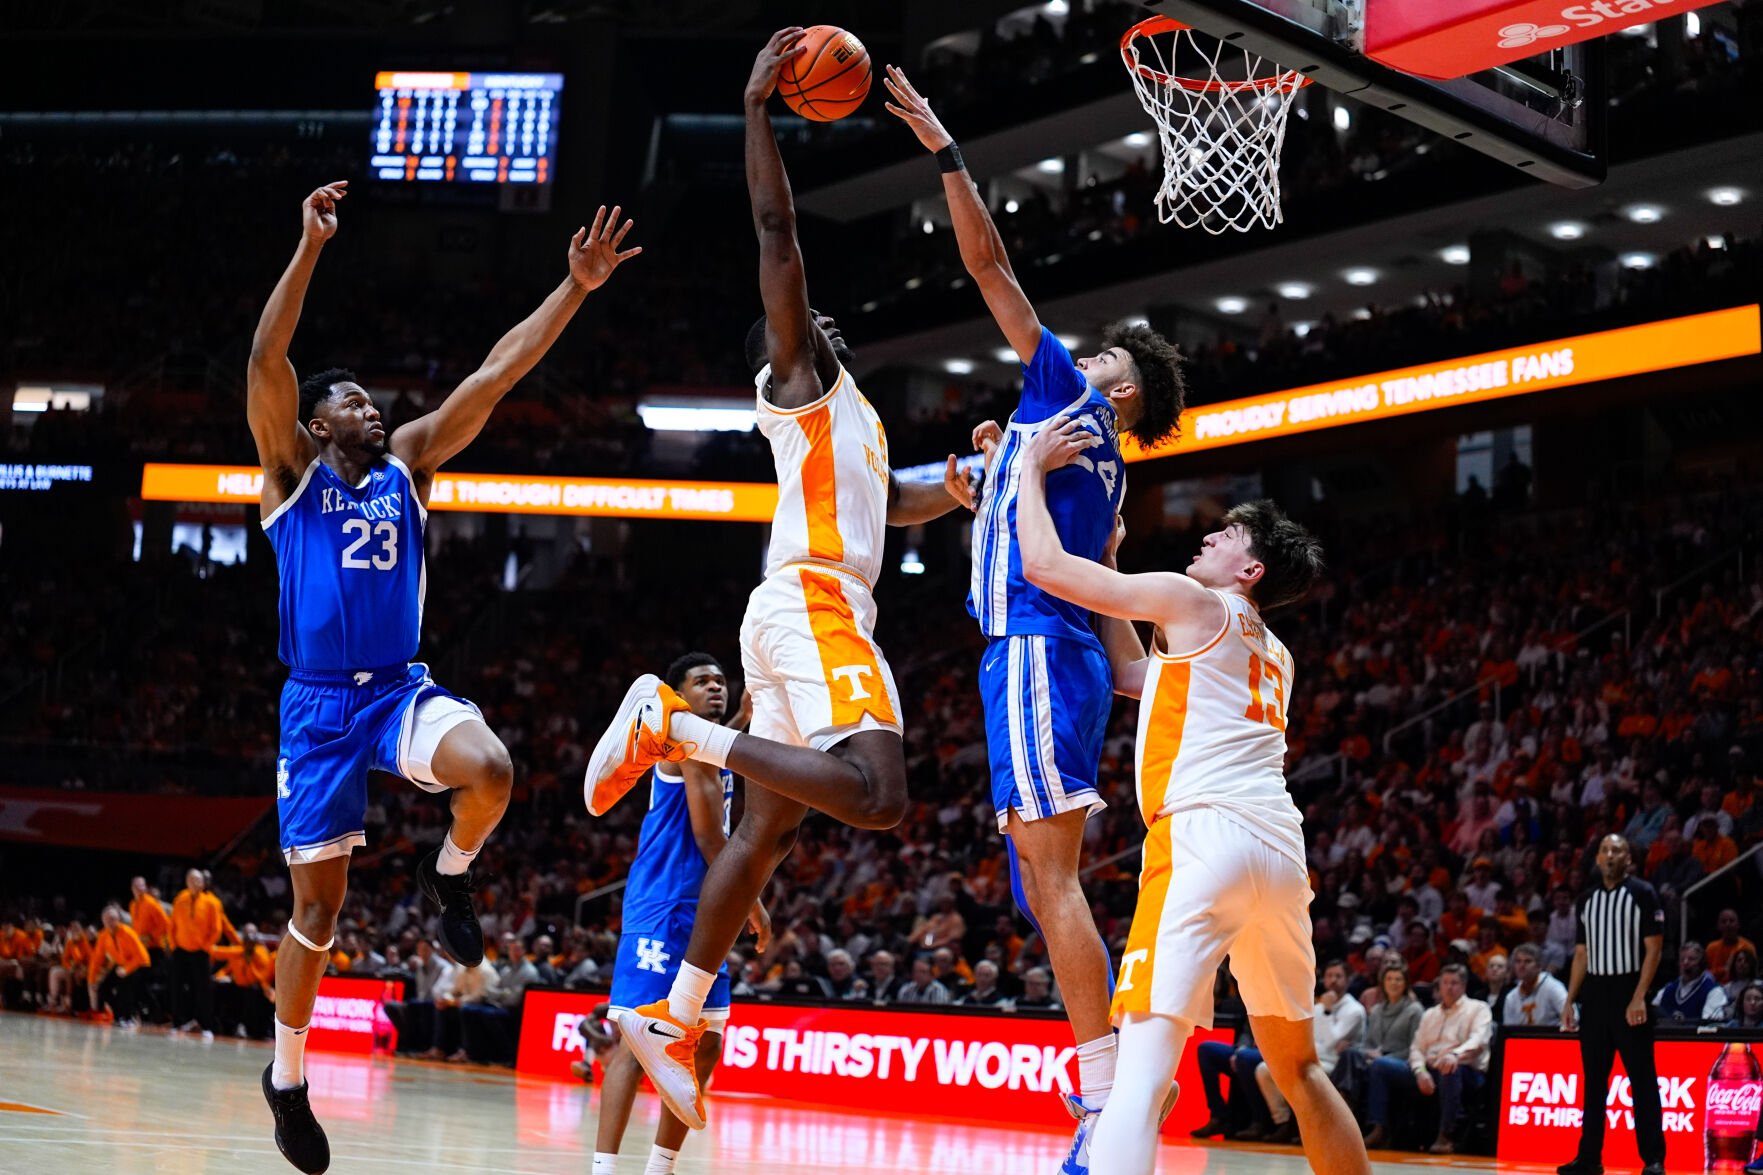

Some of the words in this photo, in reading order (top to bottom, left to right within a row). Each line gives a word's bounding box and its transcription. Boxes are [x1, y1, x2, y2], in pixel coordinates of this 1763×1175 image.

[1561, 0, 1675, 27] Sta
[1195, 400, 1286, 440] PROUDLY
[1288, 384, 1379, 424] SERVING
[1380, 360, 1508, 406] TENNESSEE
[1512, 348, 1574, 383] FANS
[321, 487, 401, 520] KEUCKY
[456, 481, 561, 506] THROUGH
[563, 484, 666, 510] DIFFICULT
[669, 488, 734, 512] TIMES
[342, 519, 397, 570] 23
[832, 664, 872, 701] T
[1245, 653, 1286, 733] 13
[1118, 948, 1148, 992] T
[552, 1012, 588, 1052] FA
[723, 1025, 760, 1069] IS
[762, 1027, 929, 1082] THIRSTY
[933, 1039, 1077, 1094] WORK
[1510, 1072, 1578, 1105] FAN
[1509, 1106, 1530, 1126] IS
